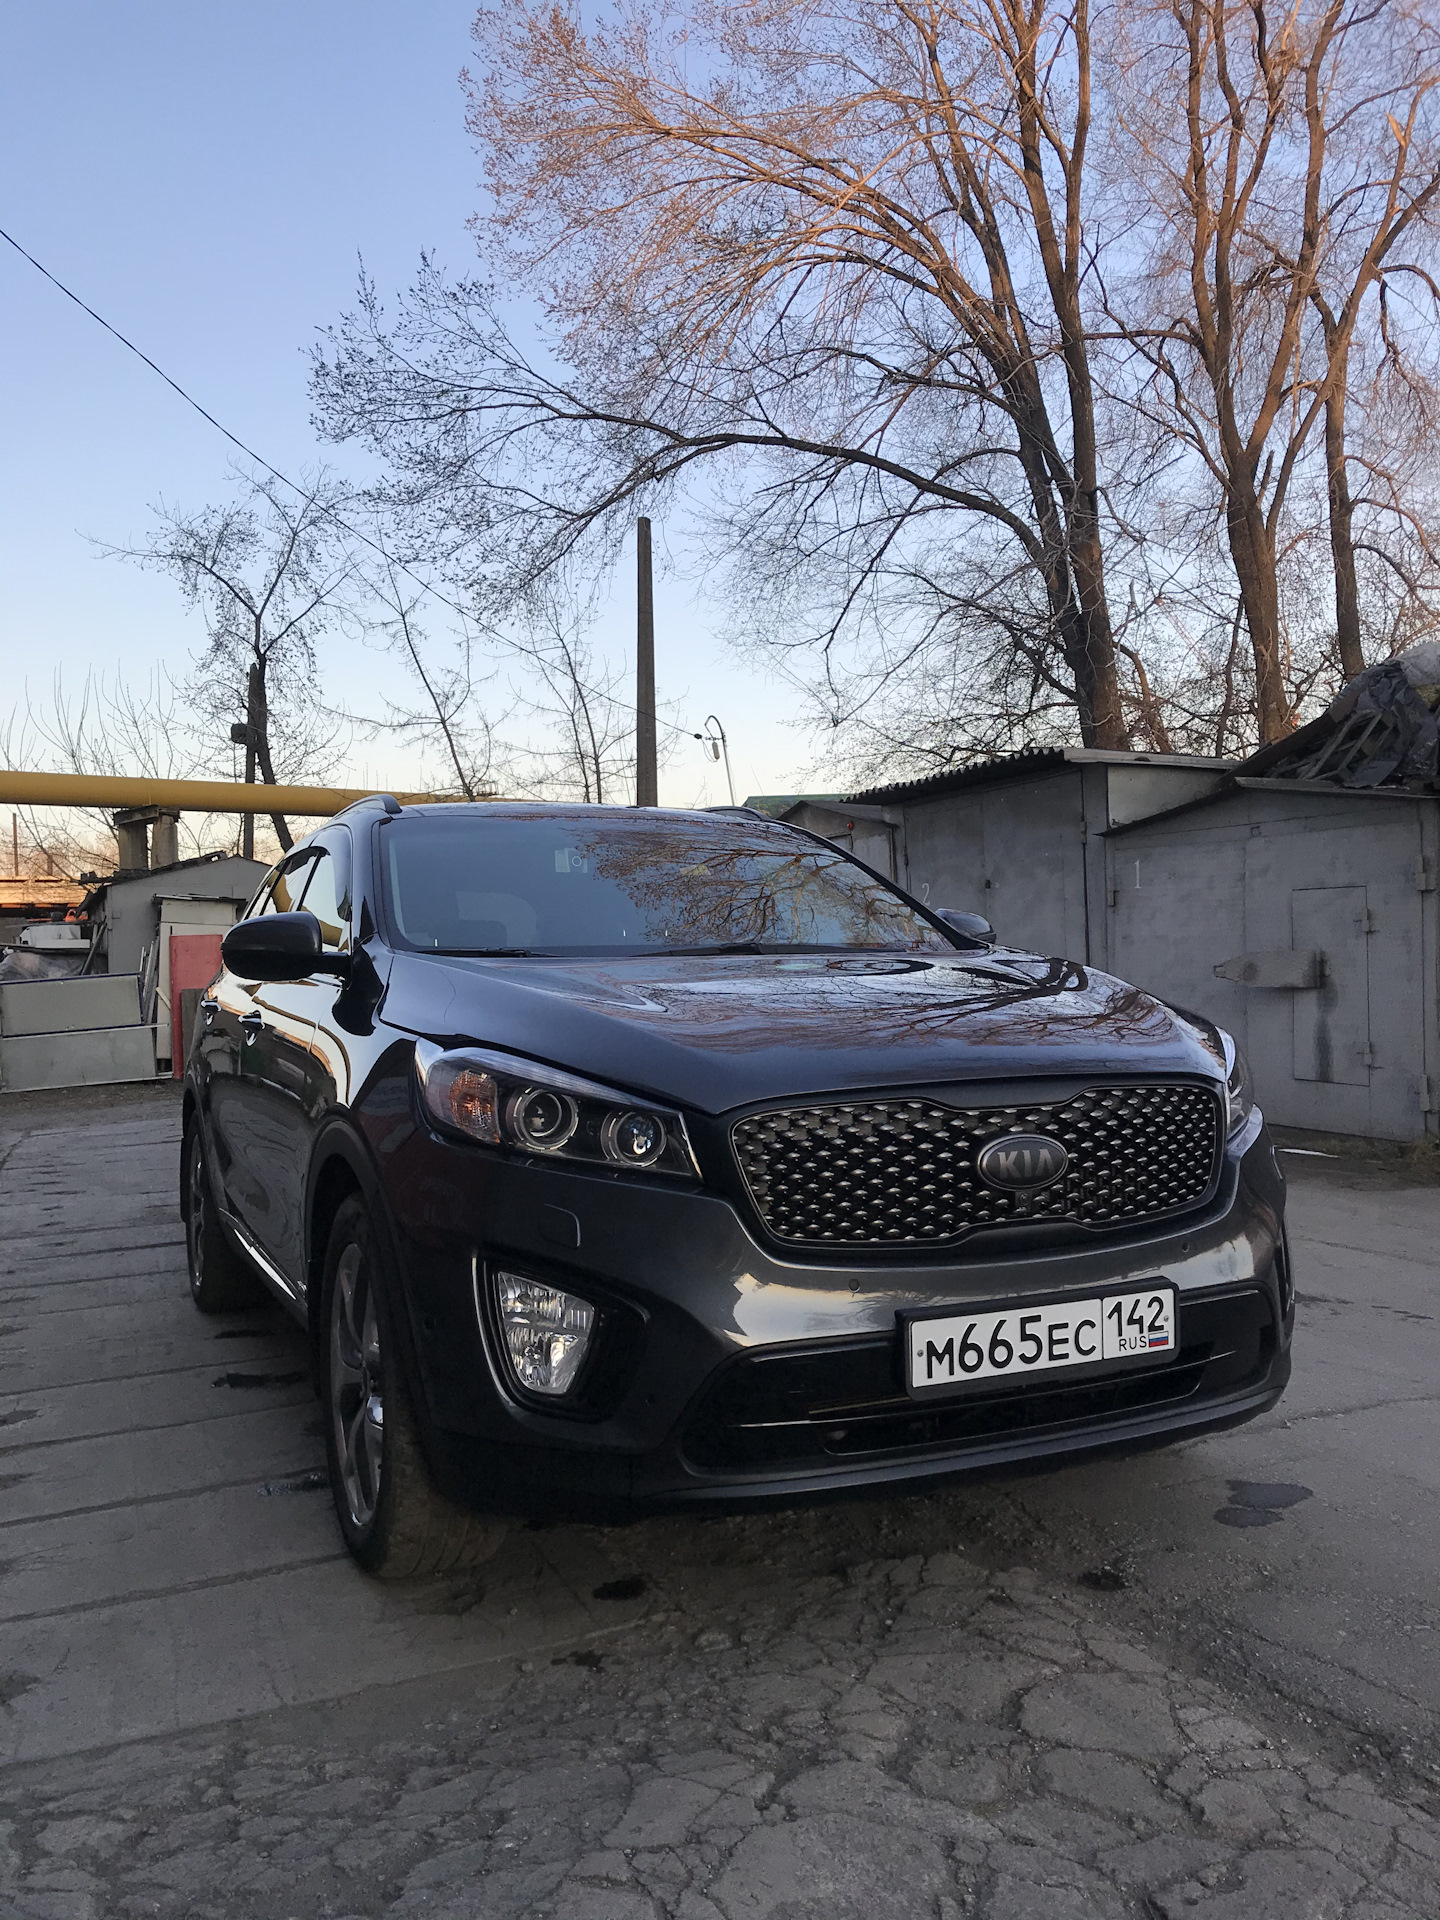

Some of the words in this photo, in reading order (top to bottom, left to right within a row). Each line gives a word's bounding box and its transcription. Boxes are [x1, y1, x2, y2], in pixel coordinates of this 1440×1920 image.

[1133, 859, 1142, 889] 1
[921, 882, 931, 906] 2
[997, 1148, 1056, 1178] KIA
[1107, 1296, 1165, 1337] 142
[1118, 1335, 1147, 1351] RUS
